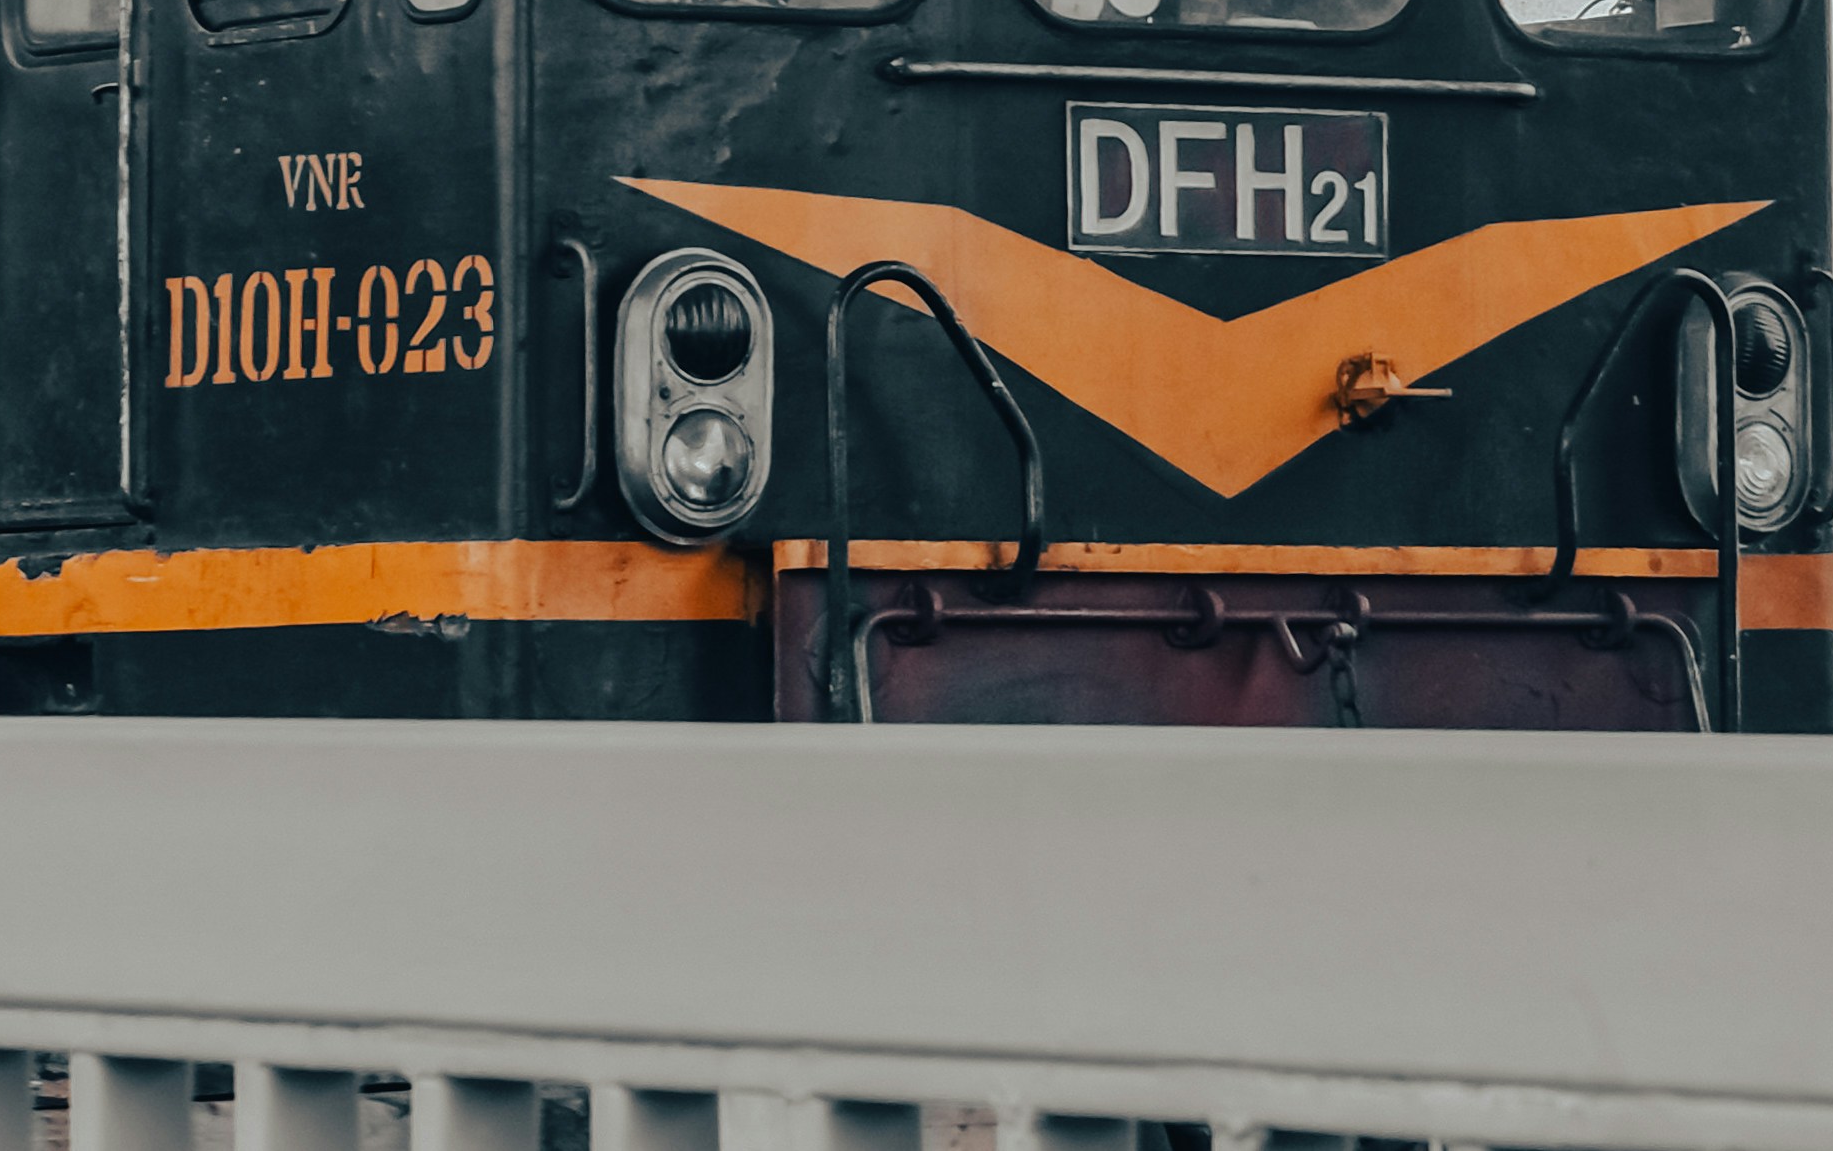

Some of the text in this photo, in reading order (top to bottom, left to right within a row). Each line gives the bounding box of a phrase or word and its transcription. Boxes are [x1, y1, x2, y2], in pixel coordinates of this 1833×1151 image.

[278, 151, 365, 211] VNR
[1080, 118, 1378, 245] DFH21
[164, 254, 495, 388] D10H-023
